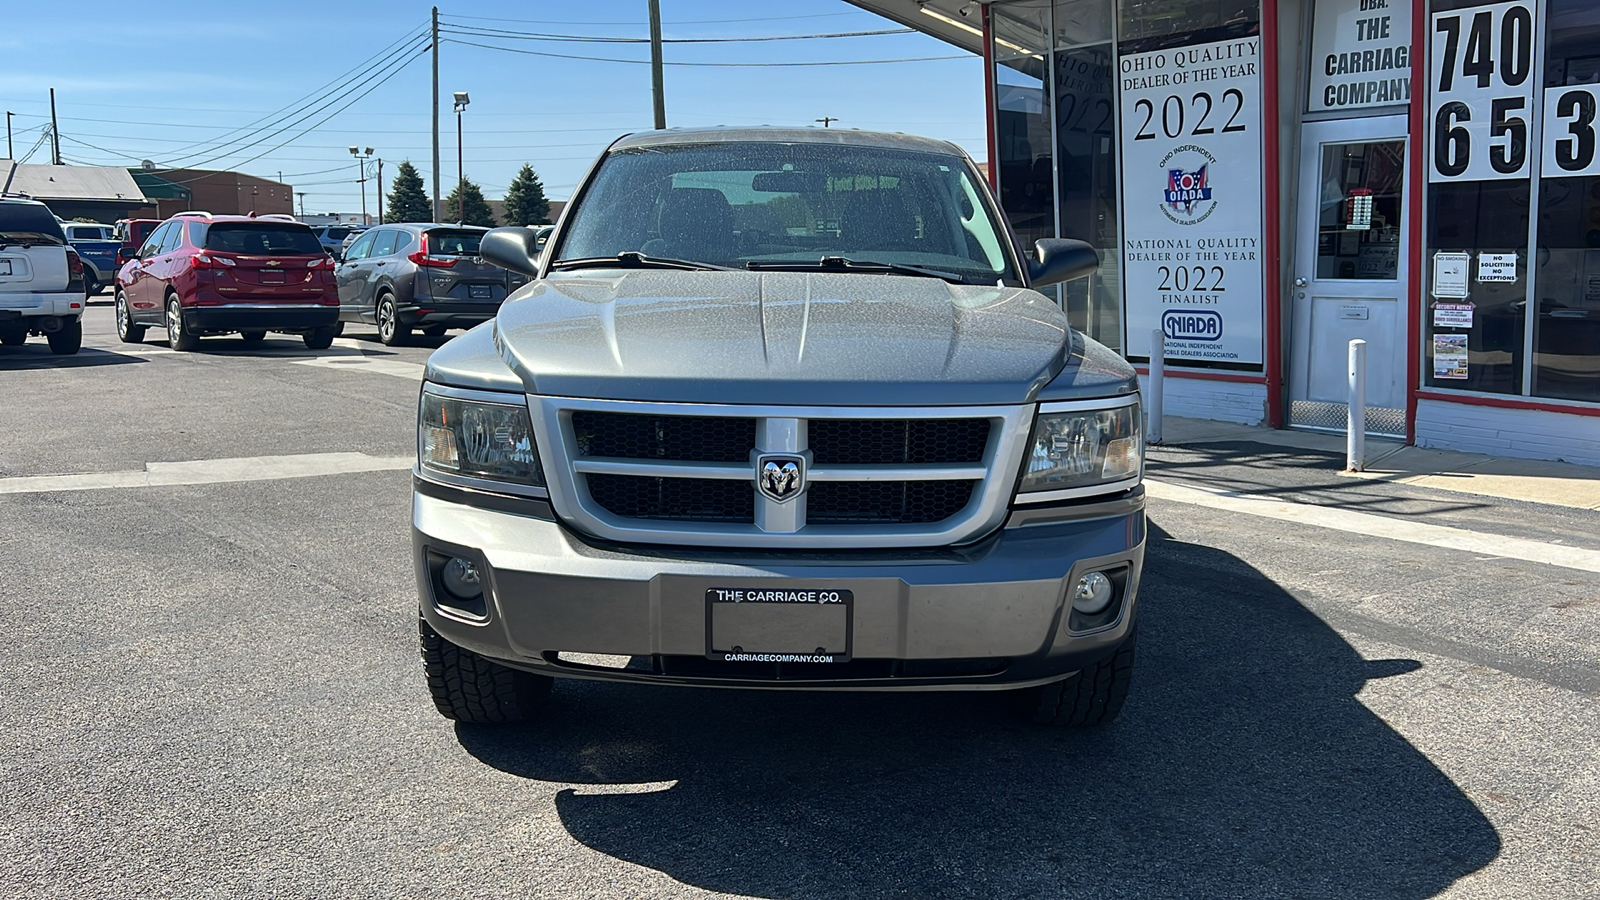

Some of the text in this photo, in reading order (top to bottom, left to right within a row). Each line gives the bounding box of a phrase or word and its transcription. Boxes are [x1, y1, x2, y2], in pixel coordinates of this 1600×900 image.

[1359, 0, 1389, 12] DBA.
[1356, 15, 1391, 42] THE
[1121, 54, 1166, 73] OHIO
[1174, 40, 1258, 68] QUALITY
[1436, 5, 1532, 93] 740
[1123, 73, 1170, 91] DEALER
[1172, 71, 1190, 85] OF
[1192, 67, 1218, 83] THE
[1221, 62, 1256, 79] YEAR
[1323, 77, 1411, 107] COMPANY
[1133, 87, 1246, 141] 2022
[1159, 144, 1217, 168] OHIO INDEPENDENT
[1169, 188, 1204, 202] OIADA
[1126, 237, 1258, 250] NATIONAL QUALITY
[1128, 251, 1256, 262] DEALER OF THE YEAR
[1157, 265, 1226, 292] 2022
[1162, 294, 1220, 305] FINALIST
[1166, 315, 1217, 335] NIADA
[1188, 342, 1224, 350] INDEPENDENT
[1202, 351, 1239, 359] ASSOCIATION
[717, 590, 842, 604] THE CARRIAGE CO.
[724, 653, 834, 663] CARRIAGECOMPANY.COM
